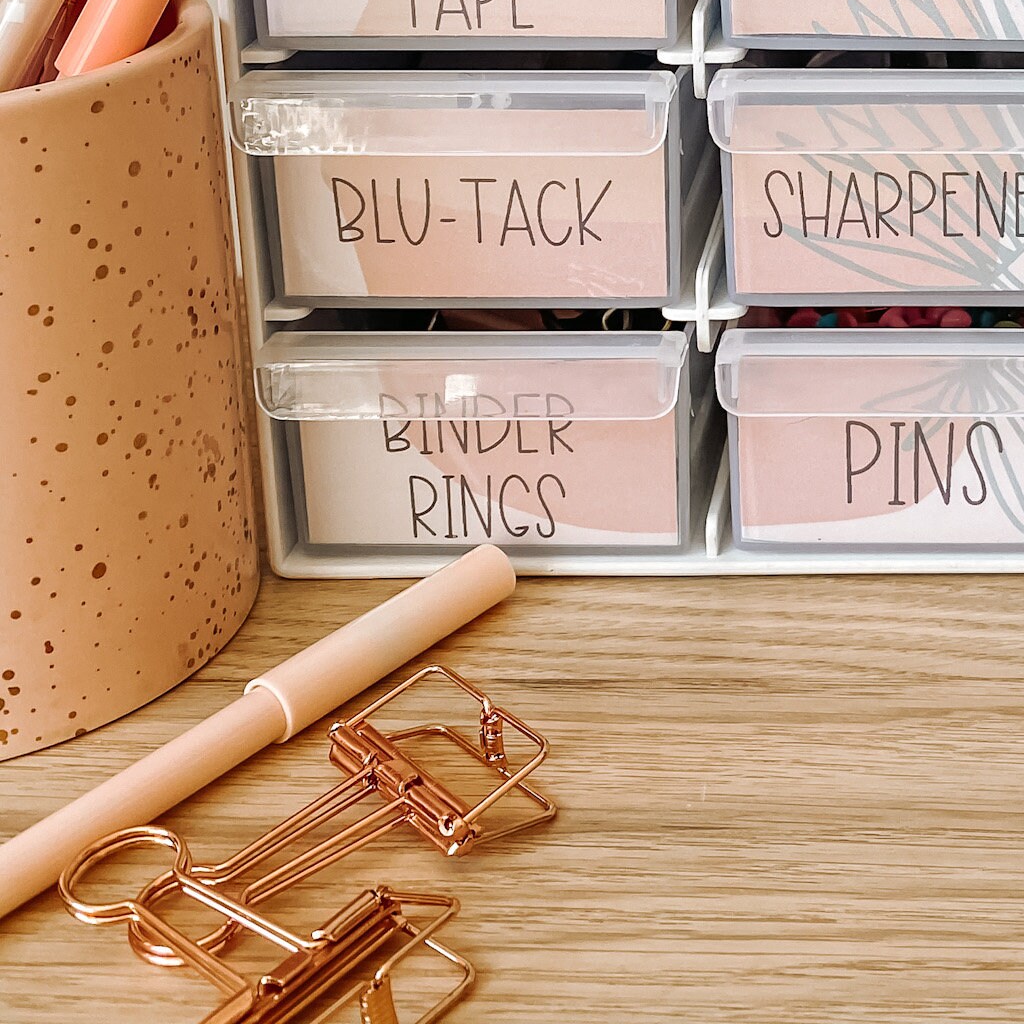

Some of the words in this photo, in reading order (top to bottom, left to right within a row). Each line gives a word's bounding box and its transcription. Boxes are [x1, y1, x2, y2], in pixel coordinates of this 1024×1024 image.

[332, 177, 612, 247] BLU-TACK
[380, 393, 575, 456] BINDER
[846, 419, 1004, 506] PINS
[409, 473, 567, 539] RINGS
